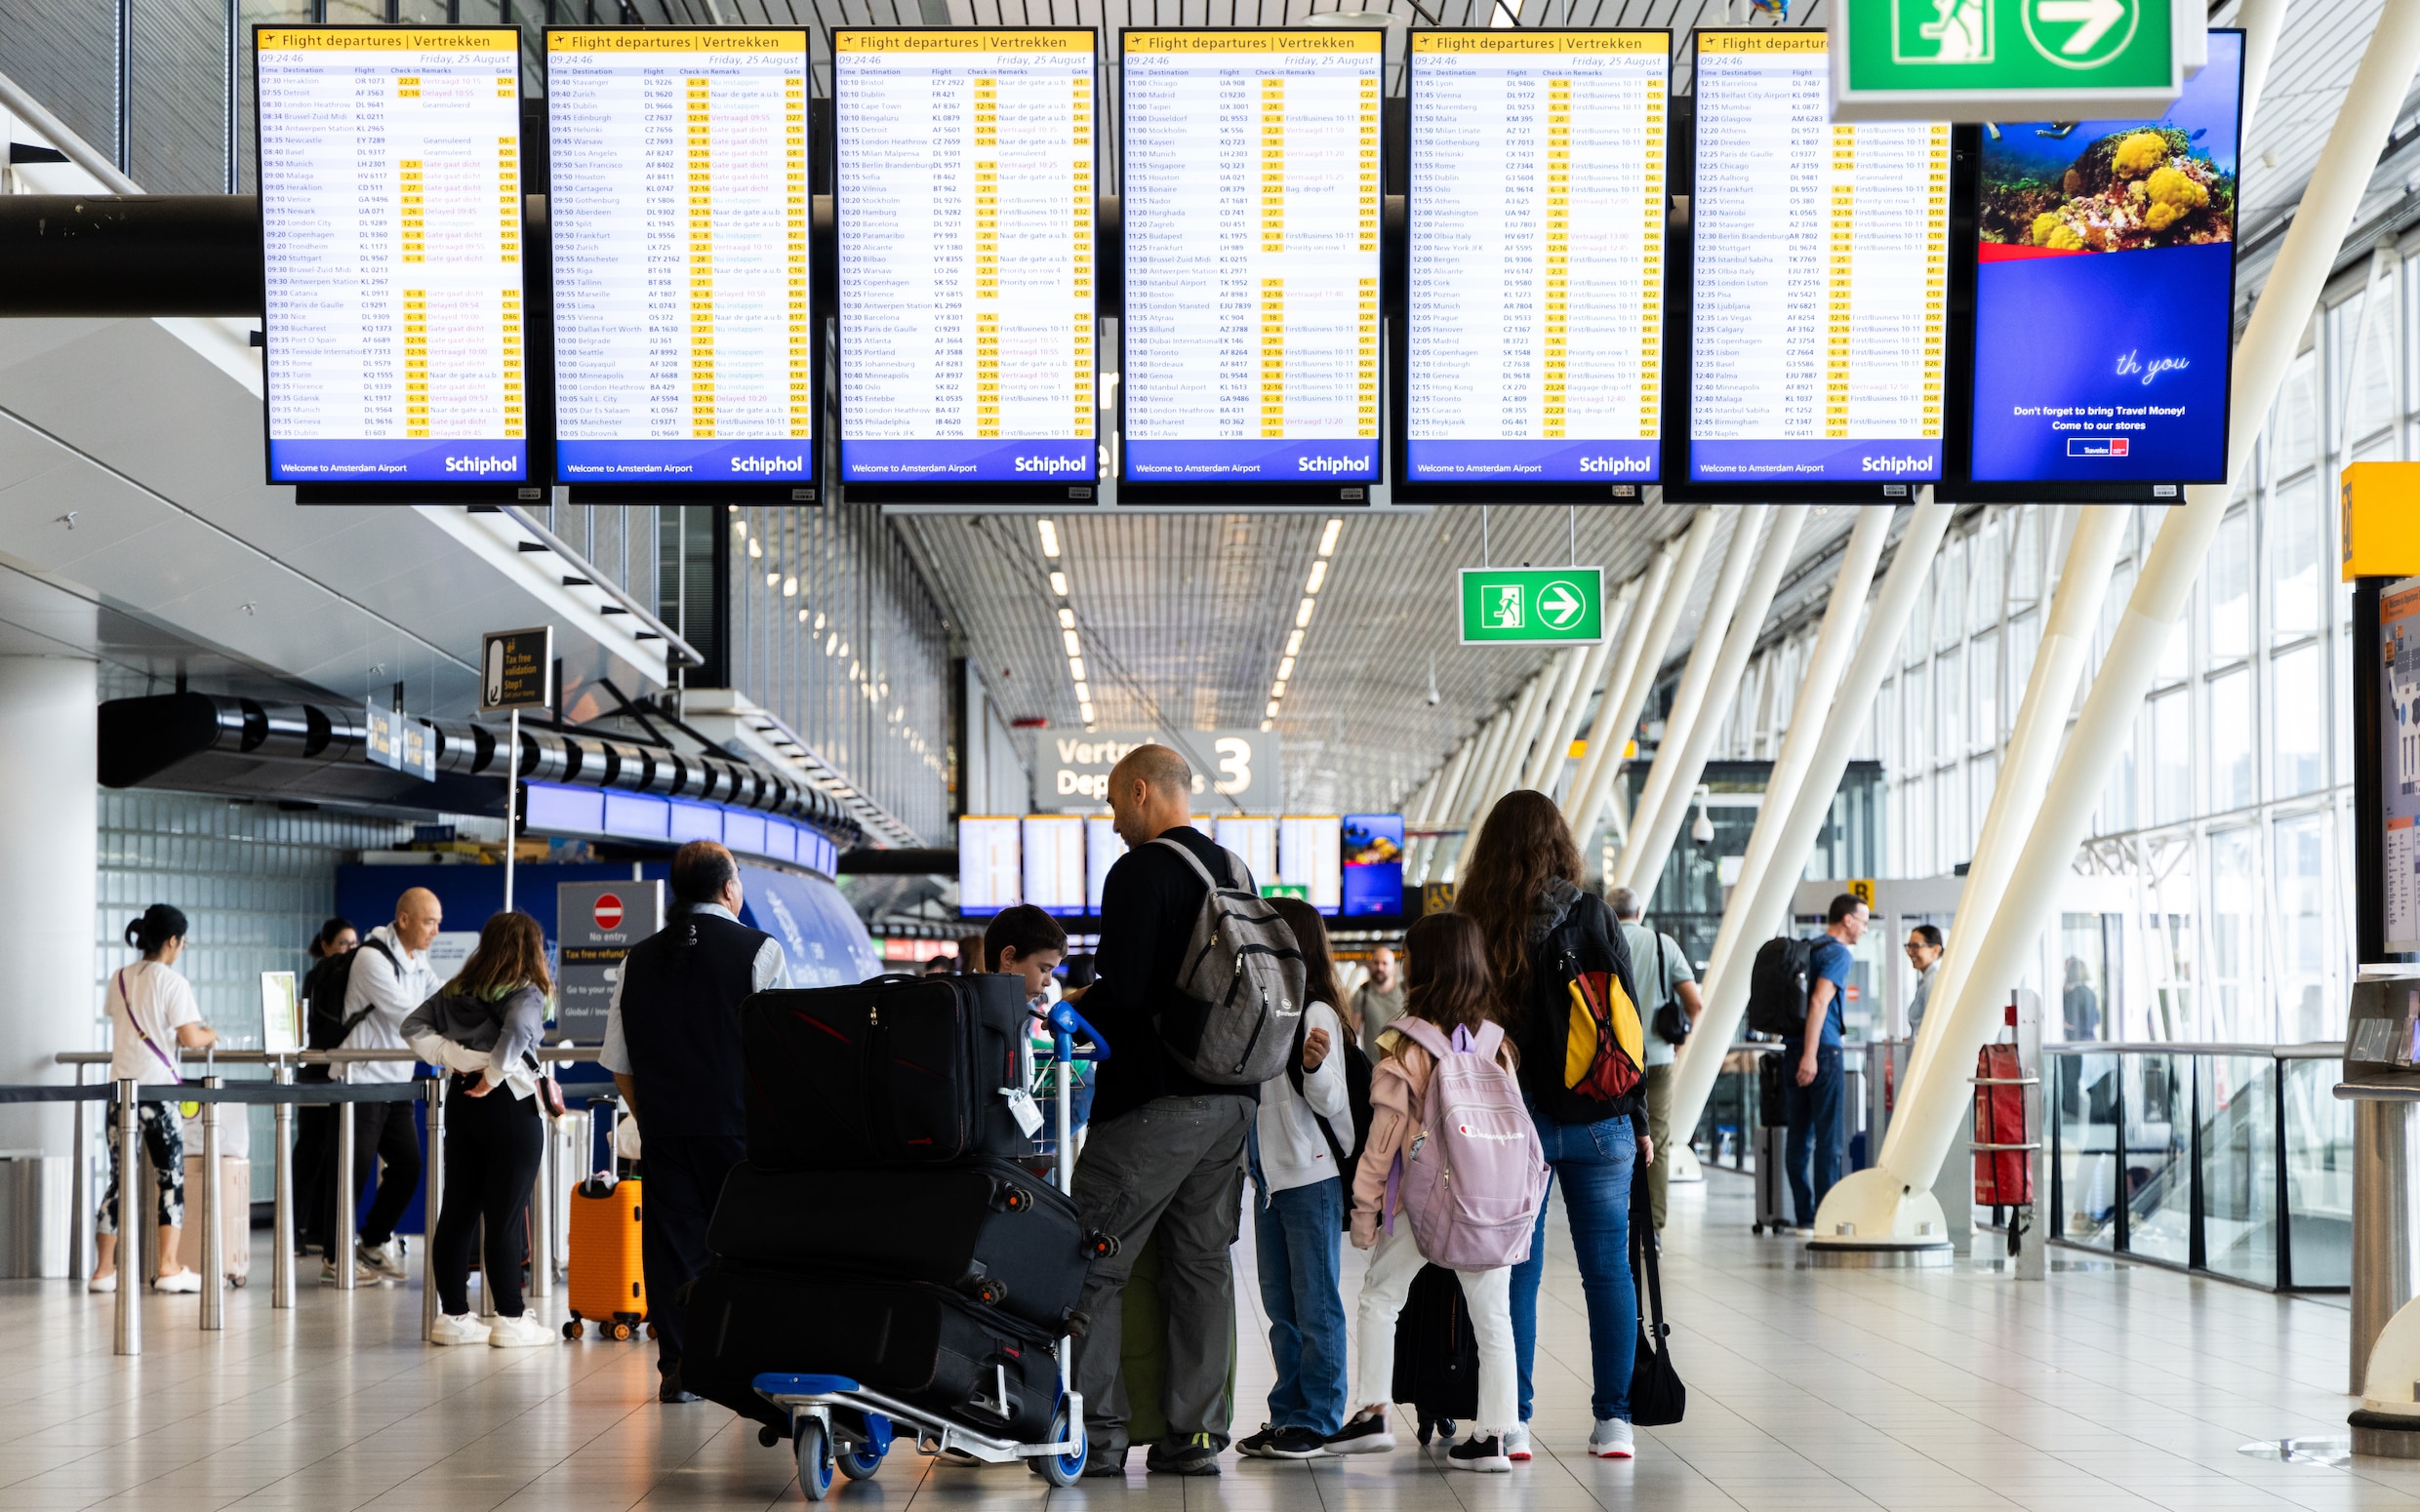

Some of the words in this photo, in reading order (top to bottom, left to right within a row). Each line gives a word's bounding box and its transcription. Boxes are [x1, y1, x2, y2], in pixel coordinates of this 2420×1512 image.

[283, 35, 321, 48] Flight
[327, 35, 401, 49] departures
[414, 35, 489, 46] Vertrekken
[573, 36, 611, 50] Flight
[616, 36, 690, 50] departures
[703, 36, 778, 47] Vertrekken
[862, 37, 899, 50] Flight
[905, 37, 978, 50] departures
[991, 37, 1066, 47] Vertrekken
[1150, 37, 1187, 51] Flight
[1192, 37, 1266, 50] departures
[1279, 37, 1353, 48] Vertrekken
[1437, 37, 1475, 51] Flight
[1480, 38, 1553, 51] departures
[1567, 38, 1641, 48] Vertrekken
[1723, 38, 1761, 51] Flight
[421, 55, 454, 64] Friday,
[473, 56, 509, 64] August
[709, 56, 742, 65] Friday,
[761, 56, 798, 65] August
[997, 56, 1029, 65] Friday,
[1049, 57, 1085, 65] August
[1285, 57, 1317, 66] Friday,
[1337, 57, 1373, 66] August
[1573, 57, 1605, 67] Friday,
[1624, 58, 1661, 67] August
[2142, 357, 2190, 385] you
[2043, 406, 2074, 418] forget
[2088, 407, 2115, 417] bring
[2149, 407, 2186, 417] Money!
[2052, 421, 2082, 430] Come
[280, 464, 318, 473] Welcome
[377, 464, 407, 473] Airport
[445, 456, 518, 476] Schiphol
[663, 464, 693, 473] Airport
[731, 456, 802, 474] Schiphol
[948, 464, 977, 473] Airport
[1016, 456, 1085, 474] Schiphol
[1231, 464, 1260, 473] Airport
[1299, 456, 1369, 474] Schiphol
[1513, 464, 1542, 473] Airport
[1580, 457, 1650, 475] Schiphol
[1795, 464, 1824, 473] Airport
[1863, 456, 1932, 475] Schiphol
[505, 656, 516, 664] Tax
[518, 654, 531, 662] free
[505, 665, 537, 676] validation
[1214, 736, 1252, 795] 3
[589, 933, 601, 941] No
[604, 933, 626, 944] entry
[582, 949, 596, 958] free
[598, 949, 625, 958] refund
[588, 987, 605, 996] your
[565, 1008, 587, 1016] Global
[1458, 1124, 1525, 1147] Champion
